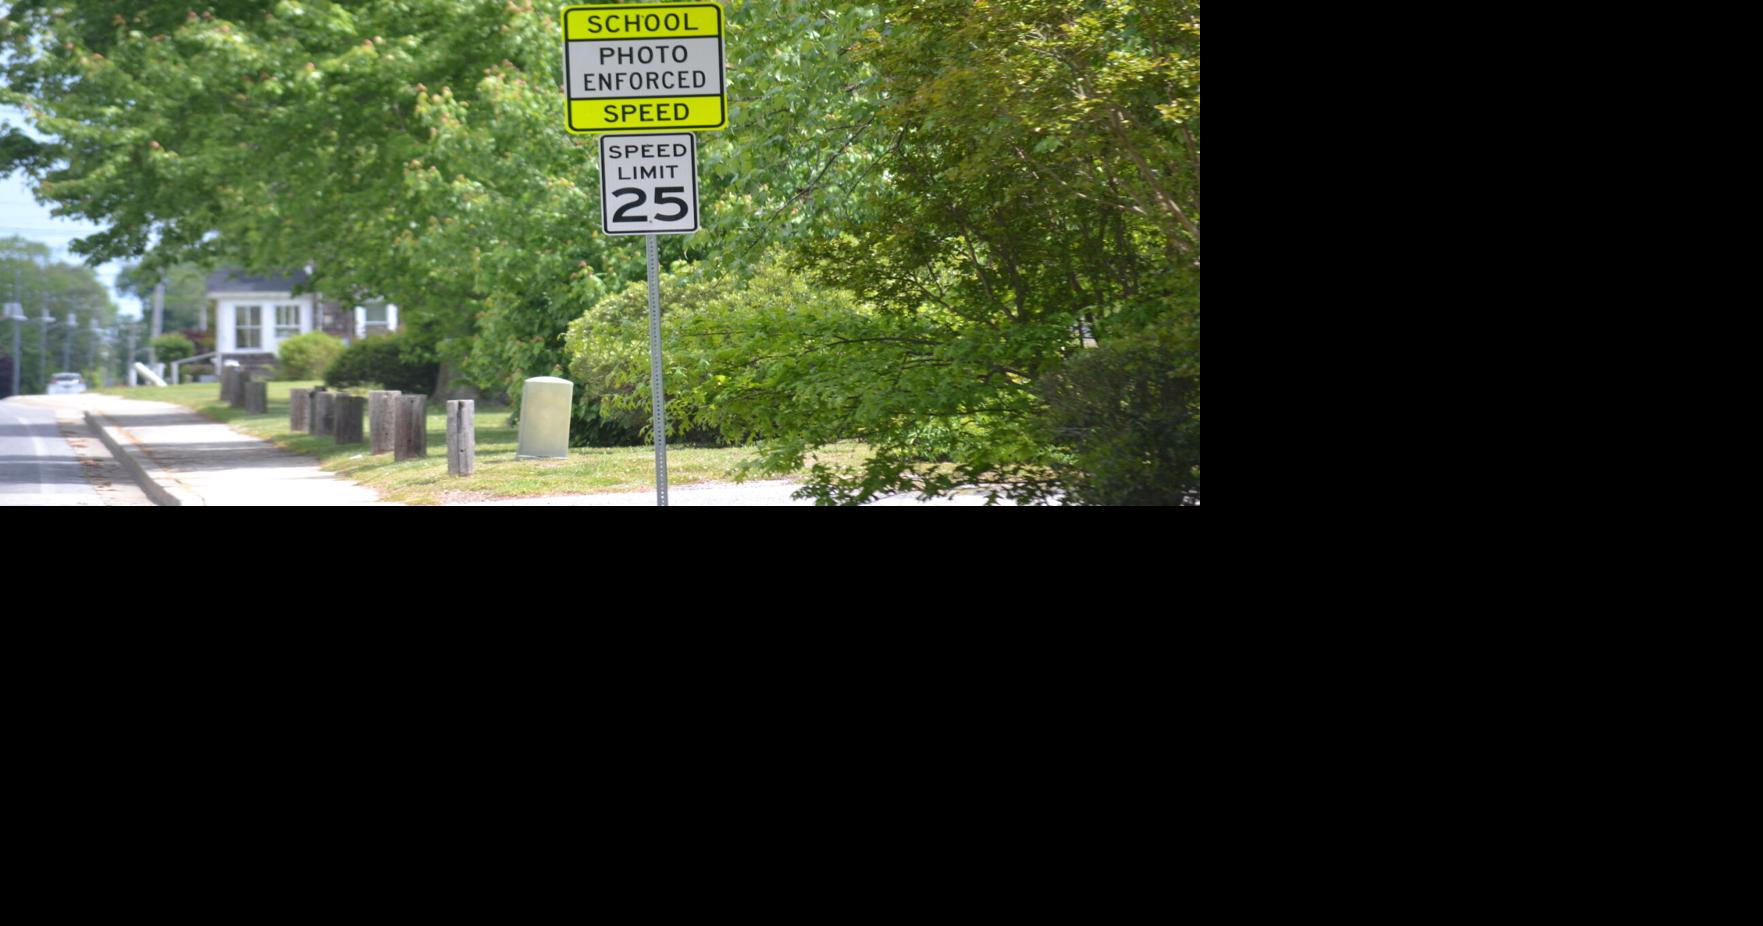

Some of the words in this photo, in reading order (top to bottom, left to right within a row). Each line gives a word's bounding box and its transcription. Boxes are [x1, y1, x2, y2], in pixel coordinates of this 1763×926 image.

[587, 13, 699, 33] SCHOOL
[599, 44, 688, 65] PHOTO
[583, 70, 706, 92] ENFORCED
[603, 102, 690, 123] SPEED
[608, 143, 687, 159] SPEED
[618, 165, 679, 180] LIMIT
[611, 186, 689, 223] 25
